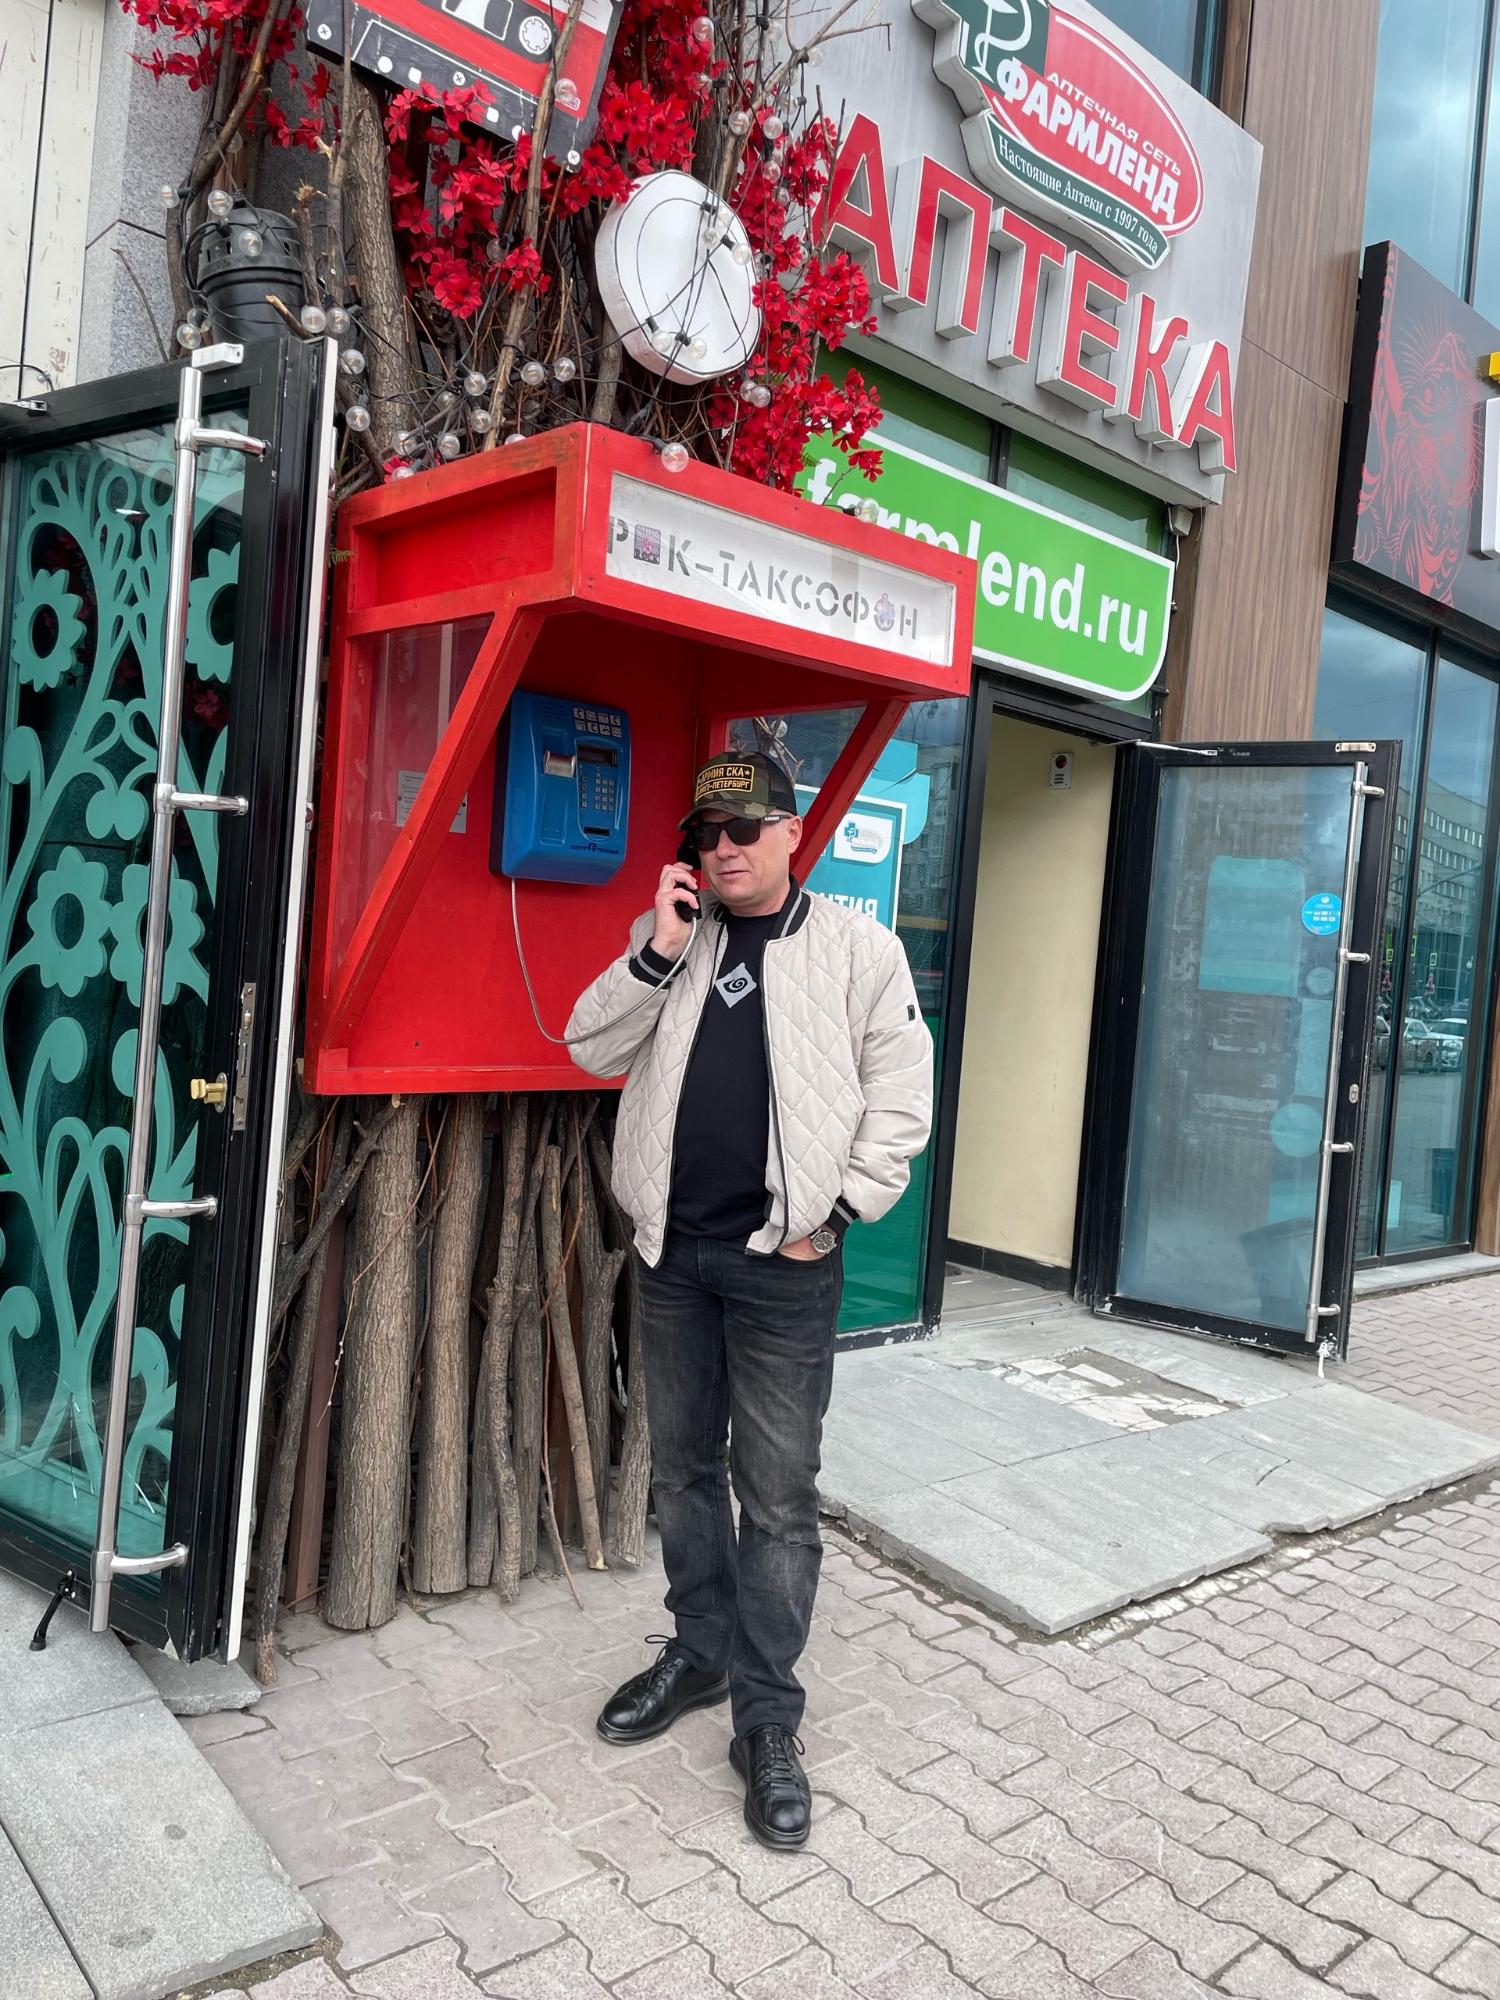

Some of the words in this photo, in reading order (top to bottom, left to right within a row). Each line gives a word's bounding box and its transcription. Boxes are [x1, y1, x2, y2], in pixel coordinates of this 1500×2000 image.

[997, 57, 1181, 225] ФАРМЛЕНД
[998, 133, 1063, 195] Настоящие
[1063, 183, 1104, 215] Аптеки
[1104, 204, 1112, 218] с
[1113, 206, 1139, 232] 1997
[1138, 223, 1159, 254] года
[1046, 71, 1139, 141] АПТЕЧНАЯ
[1142, 135, 1182, 177] СЕТЬ
[808, 111, 1238, 473] АПТЕКА
[806, 458, 1148, 657] flend.ru
[726, 766, 744, 777] СКА
